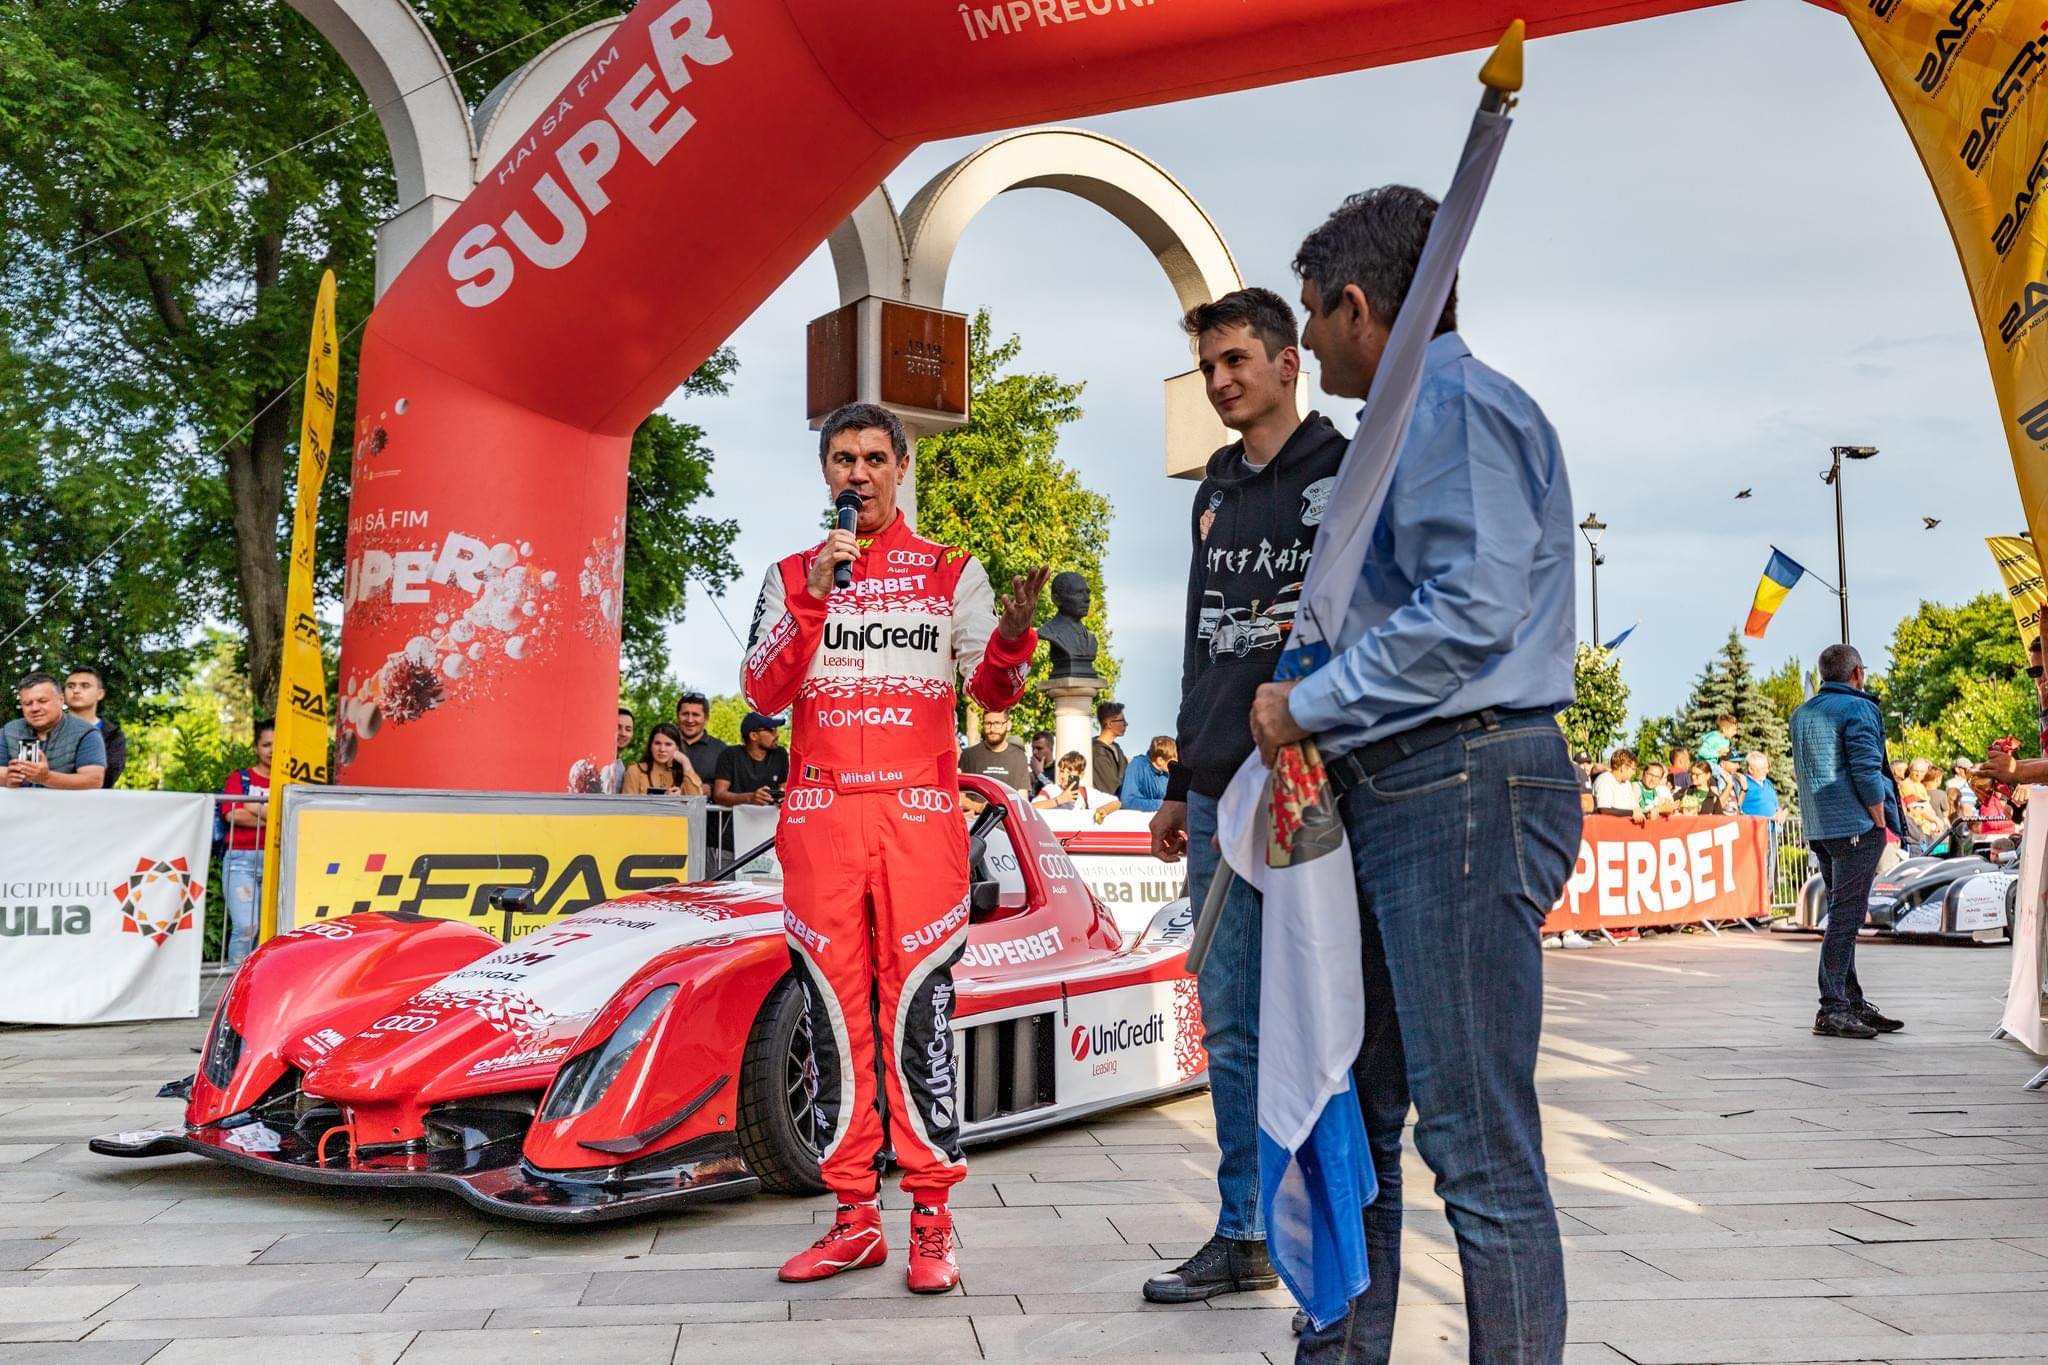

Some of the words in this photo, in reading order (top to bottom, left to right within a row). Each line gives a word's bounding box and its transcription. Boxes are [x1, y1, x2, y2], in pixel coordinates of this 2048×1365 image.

[957, 0, 1158, 41] ÎMPREU
[497, 135, 538, 186] HAI
[542, 96, 574, 137] SĂ
[576, 46, 621, 99] FIM
[447, 0, 733, 308] SUPER
[364, 508, 387, 531] SĂ
[390, 510, 429, 529] FIM
[887, 566, 909, 574] Audi
[831, 574, 927, 597] PERBET
[766, 635, 793, 666] INSURANCE
[823, 622, 940, 653] UniCredit
[823, 654, 864, 672] Leasing
[818, 707, 913, 727] ROMGAZ
[840, 771, 876, 784] Mihai
[879, 770, 903, 782] Leu
[787, 815, 806, 824] Audi
[902, 812, 926, 823] Audi
[1550, 821, 1740, 917] PERBET
[3, 881, 109, 899] ICIPIULUI
[409, 853, 688, 917] FRAS
[1140, 881, 1184, 903] IULI
[784, 906, 831, 953] RBET
[901, 893, 970, 952] SUPERB
[532, 932, 594, 947] 77
[960, 926, 1064, 968] SUPERBET
[926, 983, 955, 1095] UniCredit
[1092, 1011, 1165, 1057] UniCredit
[1092, 1058, 1118, 1077] Leasing
